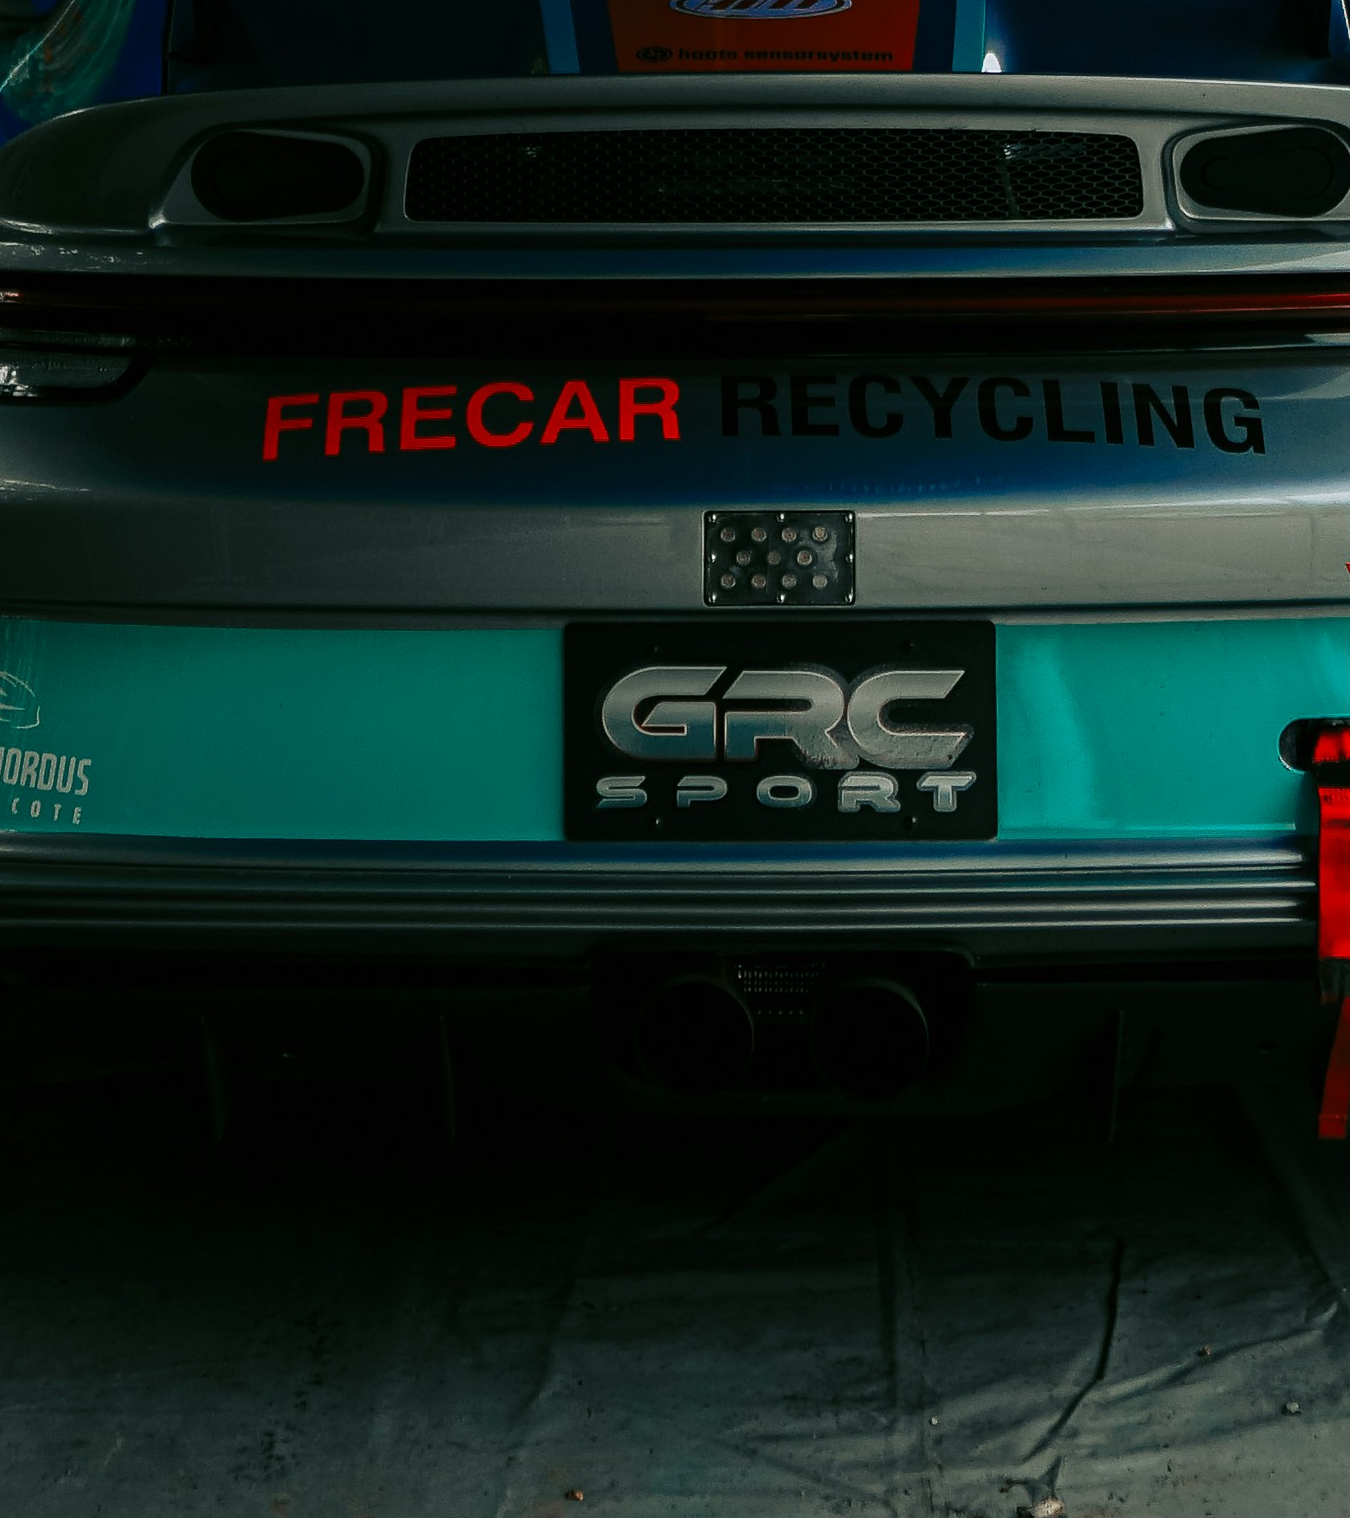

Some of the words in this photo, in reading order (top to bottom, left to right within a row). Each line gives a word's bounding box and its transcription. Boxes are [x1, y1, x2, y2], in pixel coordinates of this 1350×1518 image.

[260, 375, 683, 463] FRECAR
[720, 374, 1267, 455] RECYCLING
[594, 663, 981, 772] GRC
[11, 797, 82, 825] COTE
[593, 769, 981, 814] SPORT
